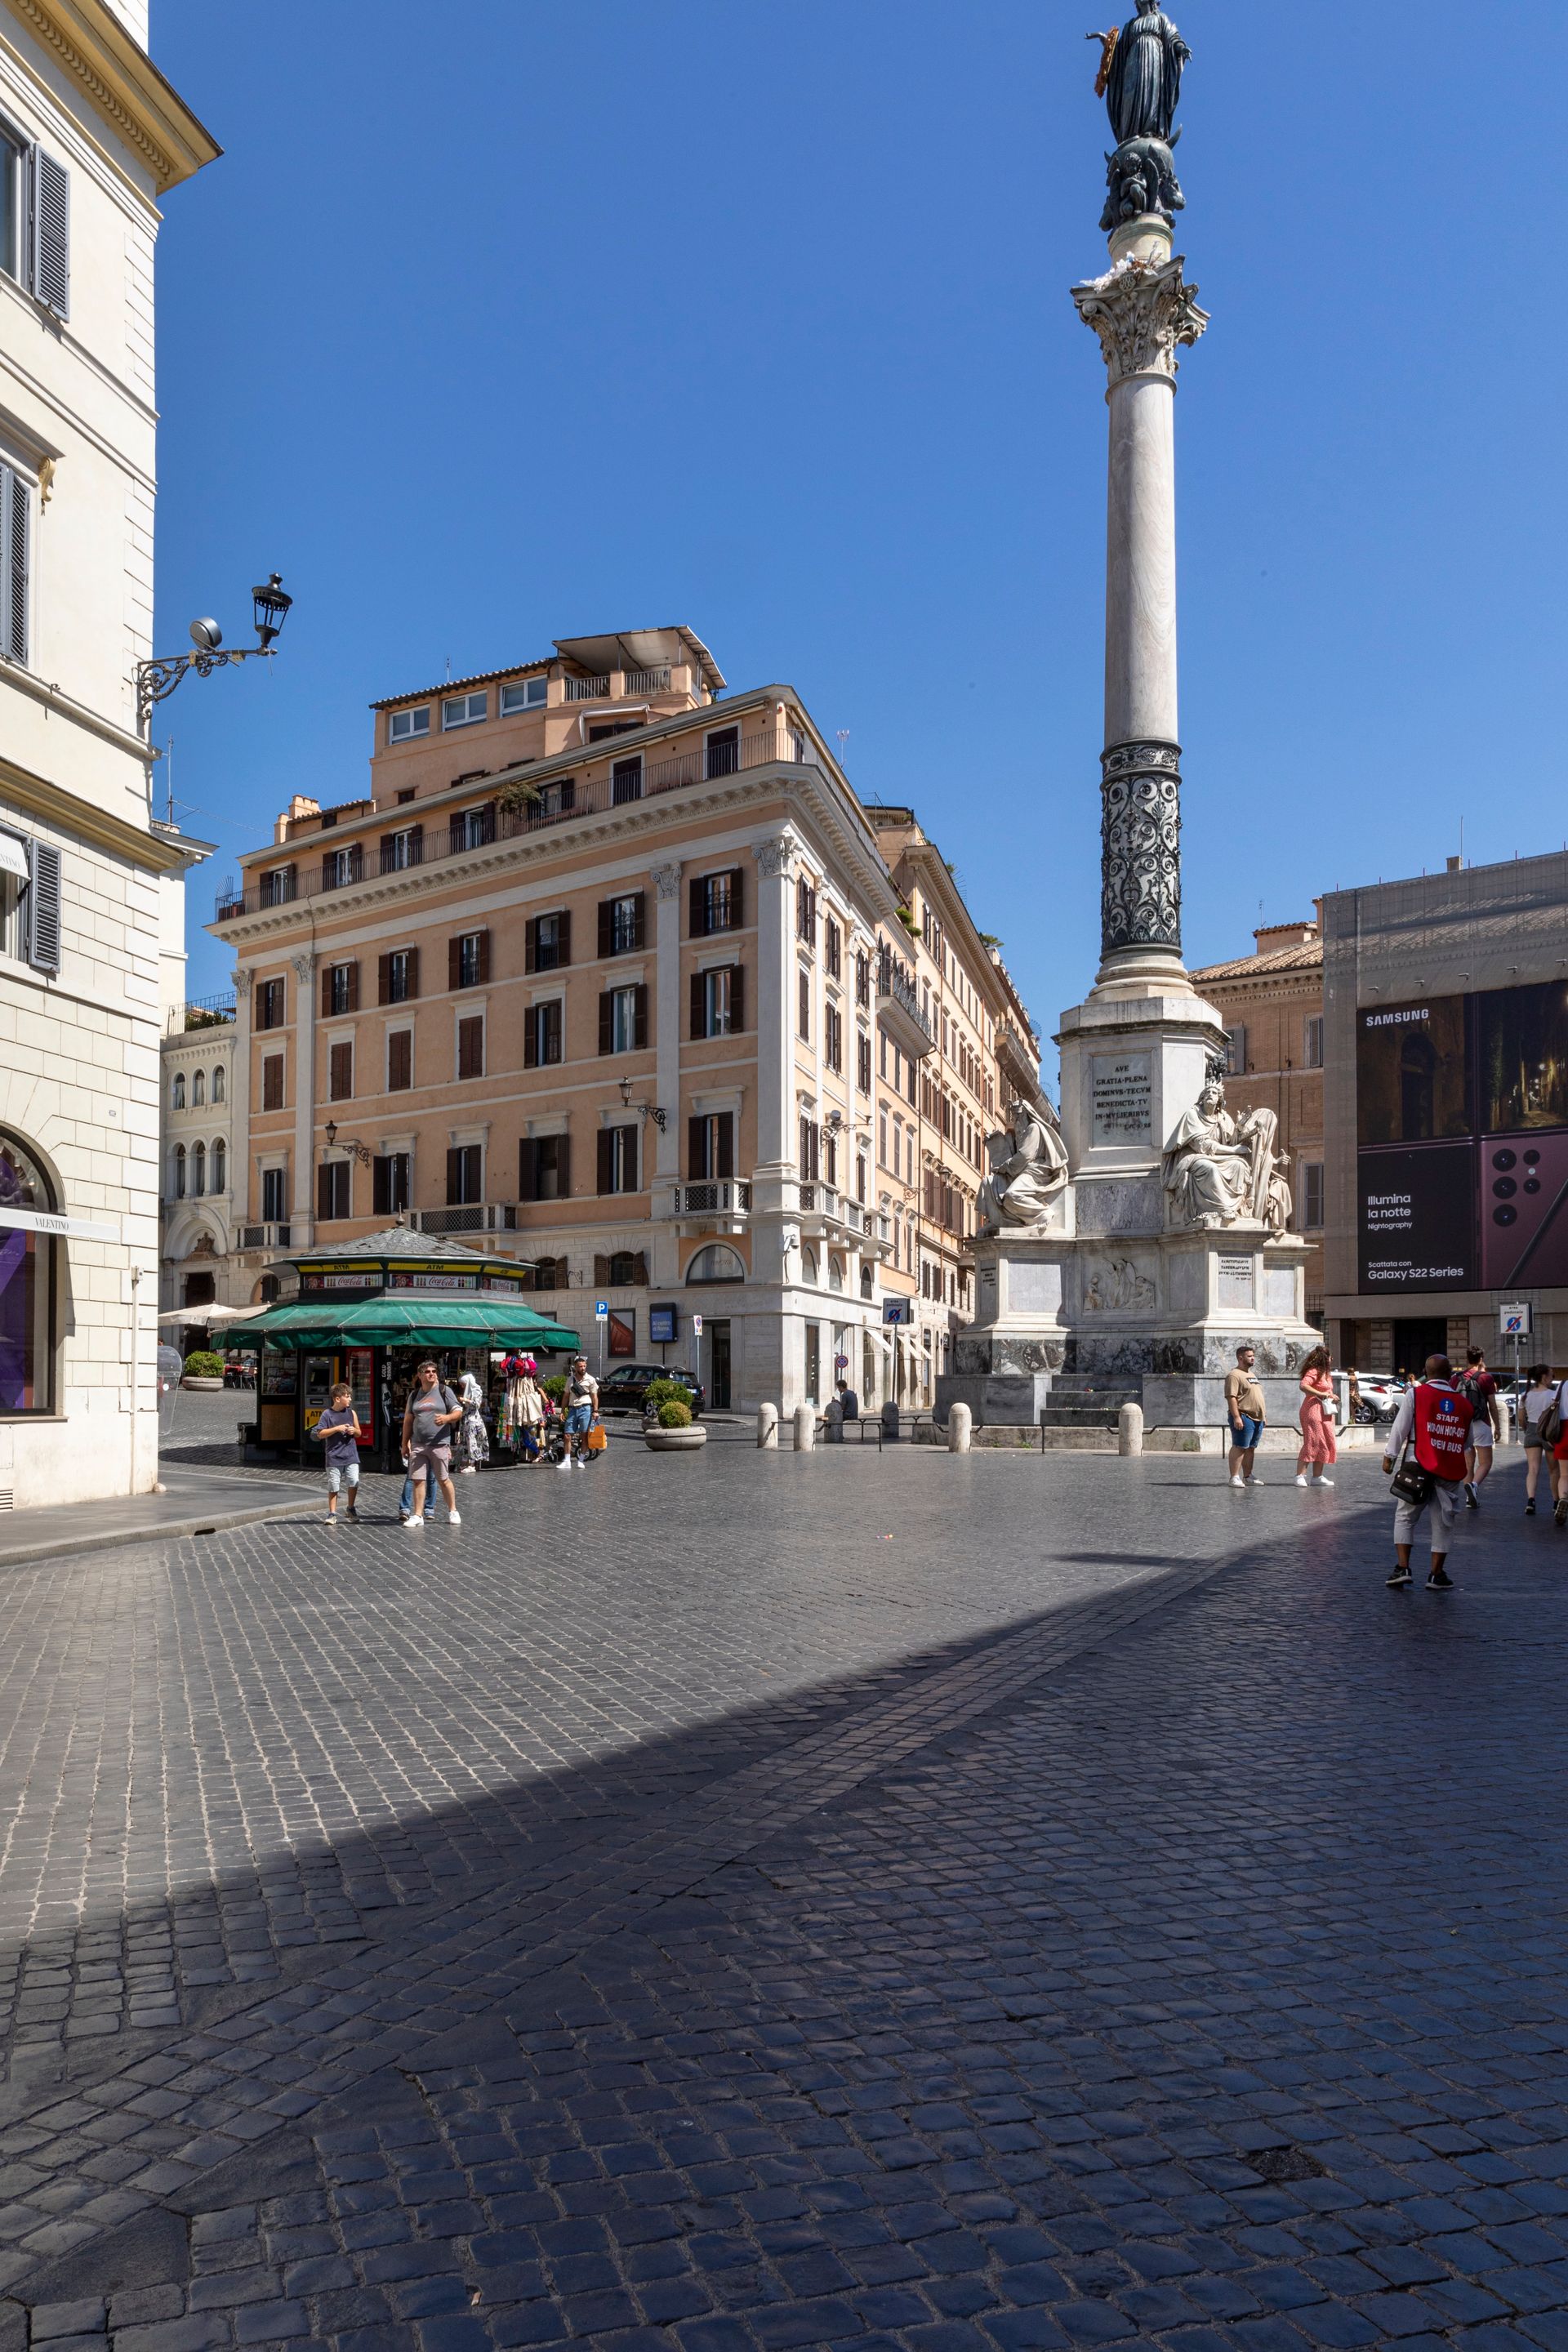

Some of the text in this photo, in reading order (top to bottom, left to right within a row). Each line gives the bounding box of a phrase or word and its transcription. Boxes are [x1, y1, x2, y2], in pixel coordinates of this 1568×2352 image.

[1365, 1009, 1429, 1027] SAMSUNG
[1367, 1193, 1411, 1205] Illumina
[1367, 1207, 1411, 1218] la notte
[35, 1217, 69, 1231] VALENTINO
[1367, 1222, 1413, 1231] Nightography
[1368, 1267, 1464, 1281] Galaxy S22 Series
[599, 1303, 605, 1313] P
[1436, 1413, 1459, 1423] STAFF
[1444, 1425, 1465, 1438] HOP-OFF
[1446, 1441, 1463, 1454] BUS
